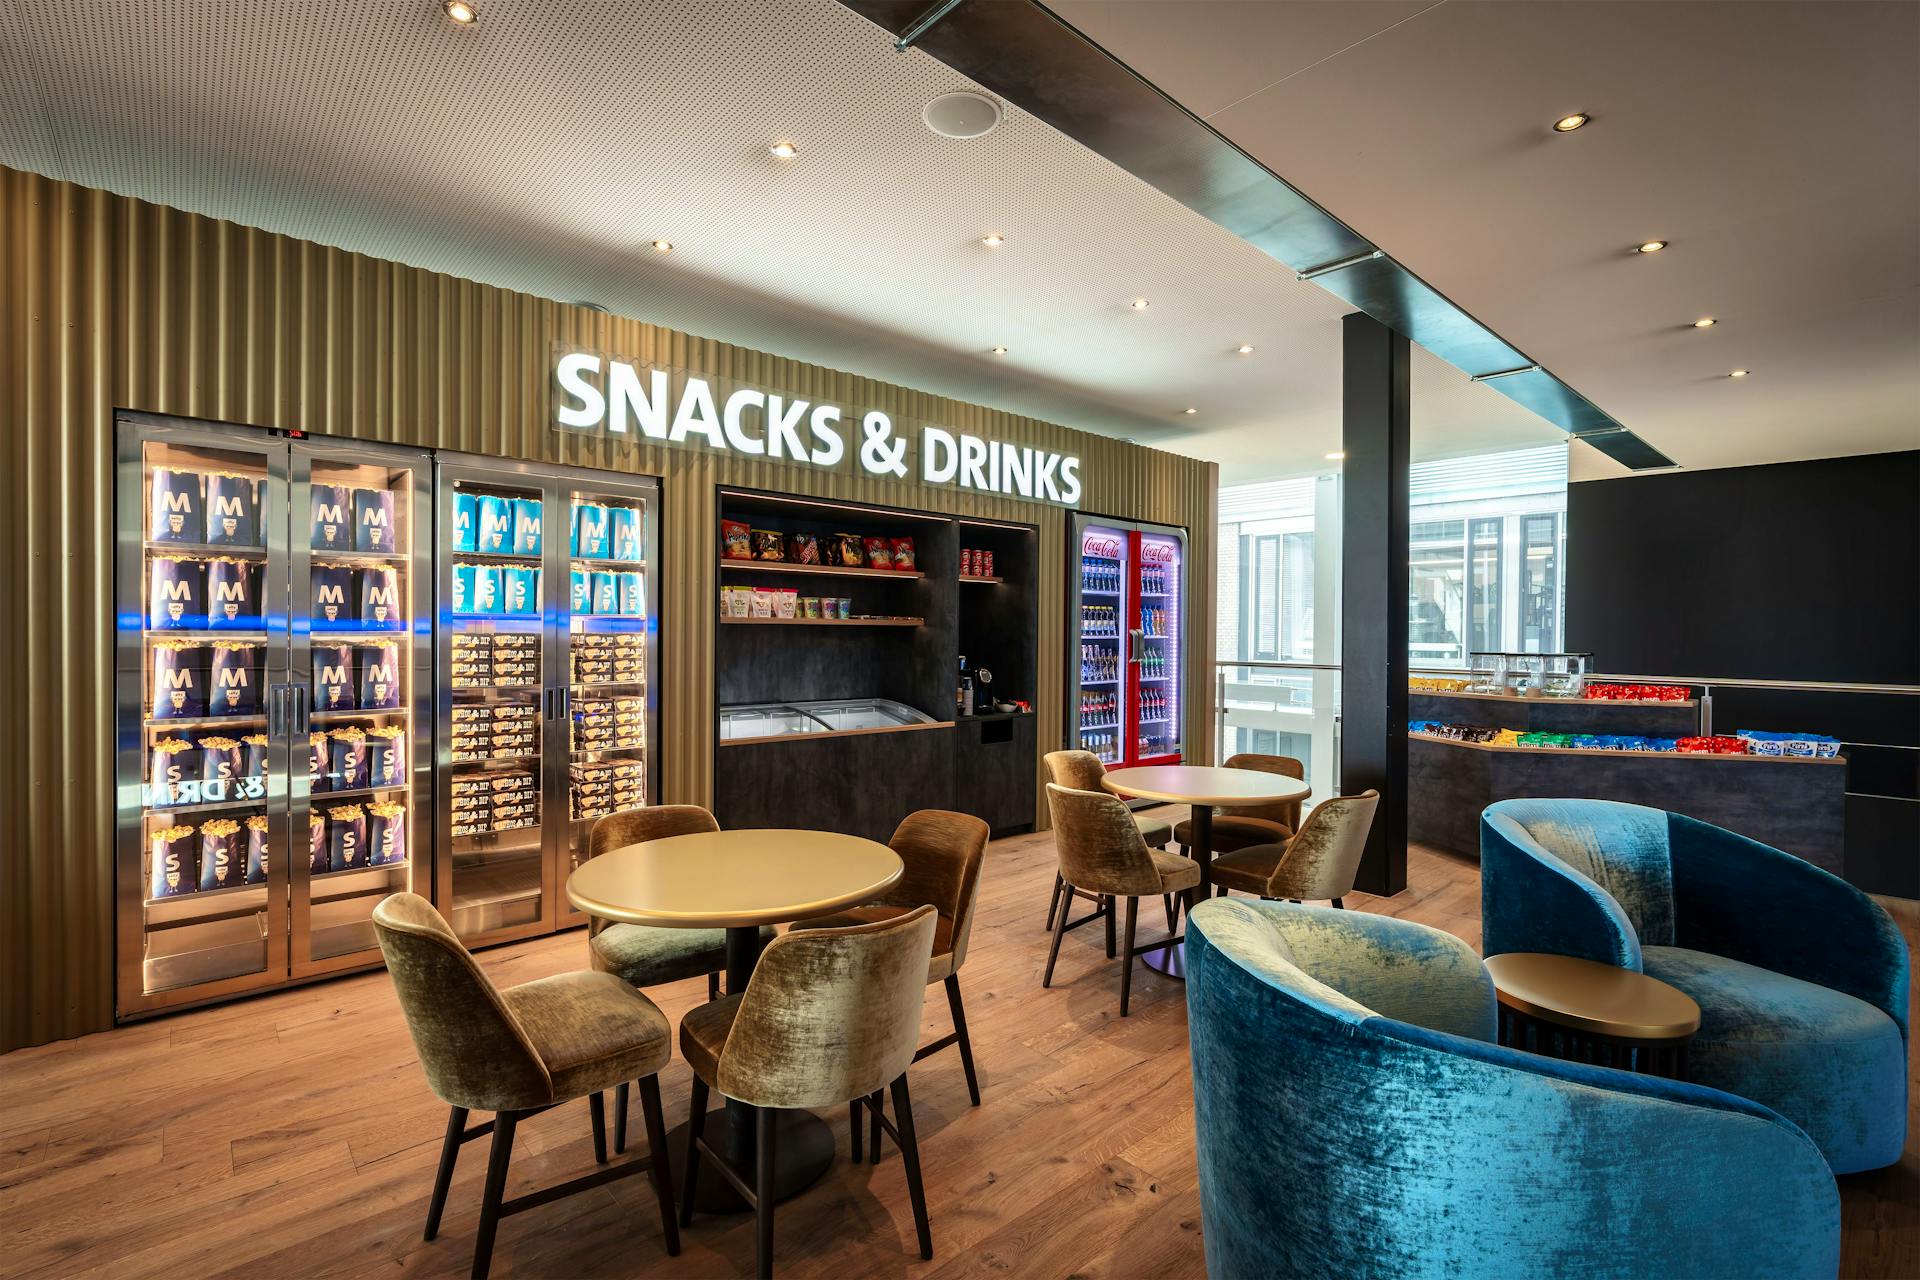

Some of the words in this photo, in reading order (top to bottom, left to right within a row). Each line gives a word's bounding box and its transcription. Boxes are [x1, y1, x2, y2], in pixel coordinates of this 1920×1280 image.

[556, 352, 845, 466] SNACKS
[860, 411, 908, 478] &
[923, 426, 1082, 504] DRINKS
[161, 491, 191, 513] M
[215, 496, 243, 516] M
[317, 504, 343, 523] M
[363, 508, 388, 526] M
[453, 511, 470, 528] M
[490, 515, 507, 532] M
[522, 517, 541, 535] M
[587, 522, 605, 538] M
[621, 524, 636, 539] M
[160, 580, 191, 600] M
[216, 581, 245, 601] M
[318, 585, 344, 603] M
[453, 578, 465, 593] S
[484, 579, 496, 594] S
[515, 581, 526, 595] S
[574, 583, 584, 596] S
[603, 584, 612, 597] S
[629, 584, 638, 597] S
[369, 586, 392, 604] M
[163, 668, 193, 688] M
[219, 668, 248, 687] M
[321, 666, 347, 684] M
[368, 664, 392, 682] M
[344, 752, 357, 768] S
[383, 750, 394, 765] S
[167, 765, 181, 782] S
[218, 762, 232, 779] S
[343, 831, 355, 848] S
[383, 828, 394, 844] S
[165, 854, 180, 871] S
[215, 849, 230, 866] S
